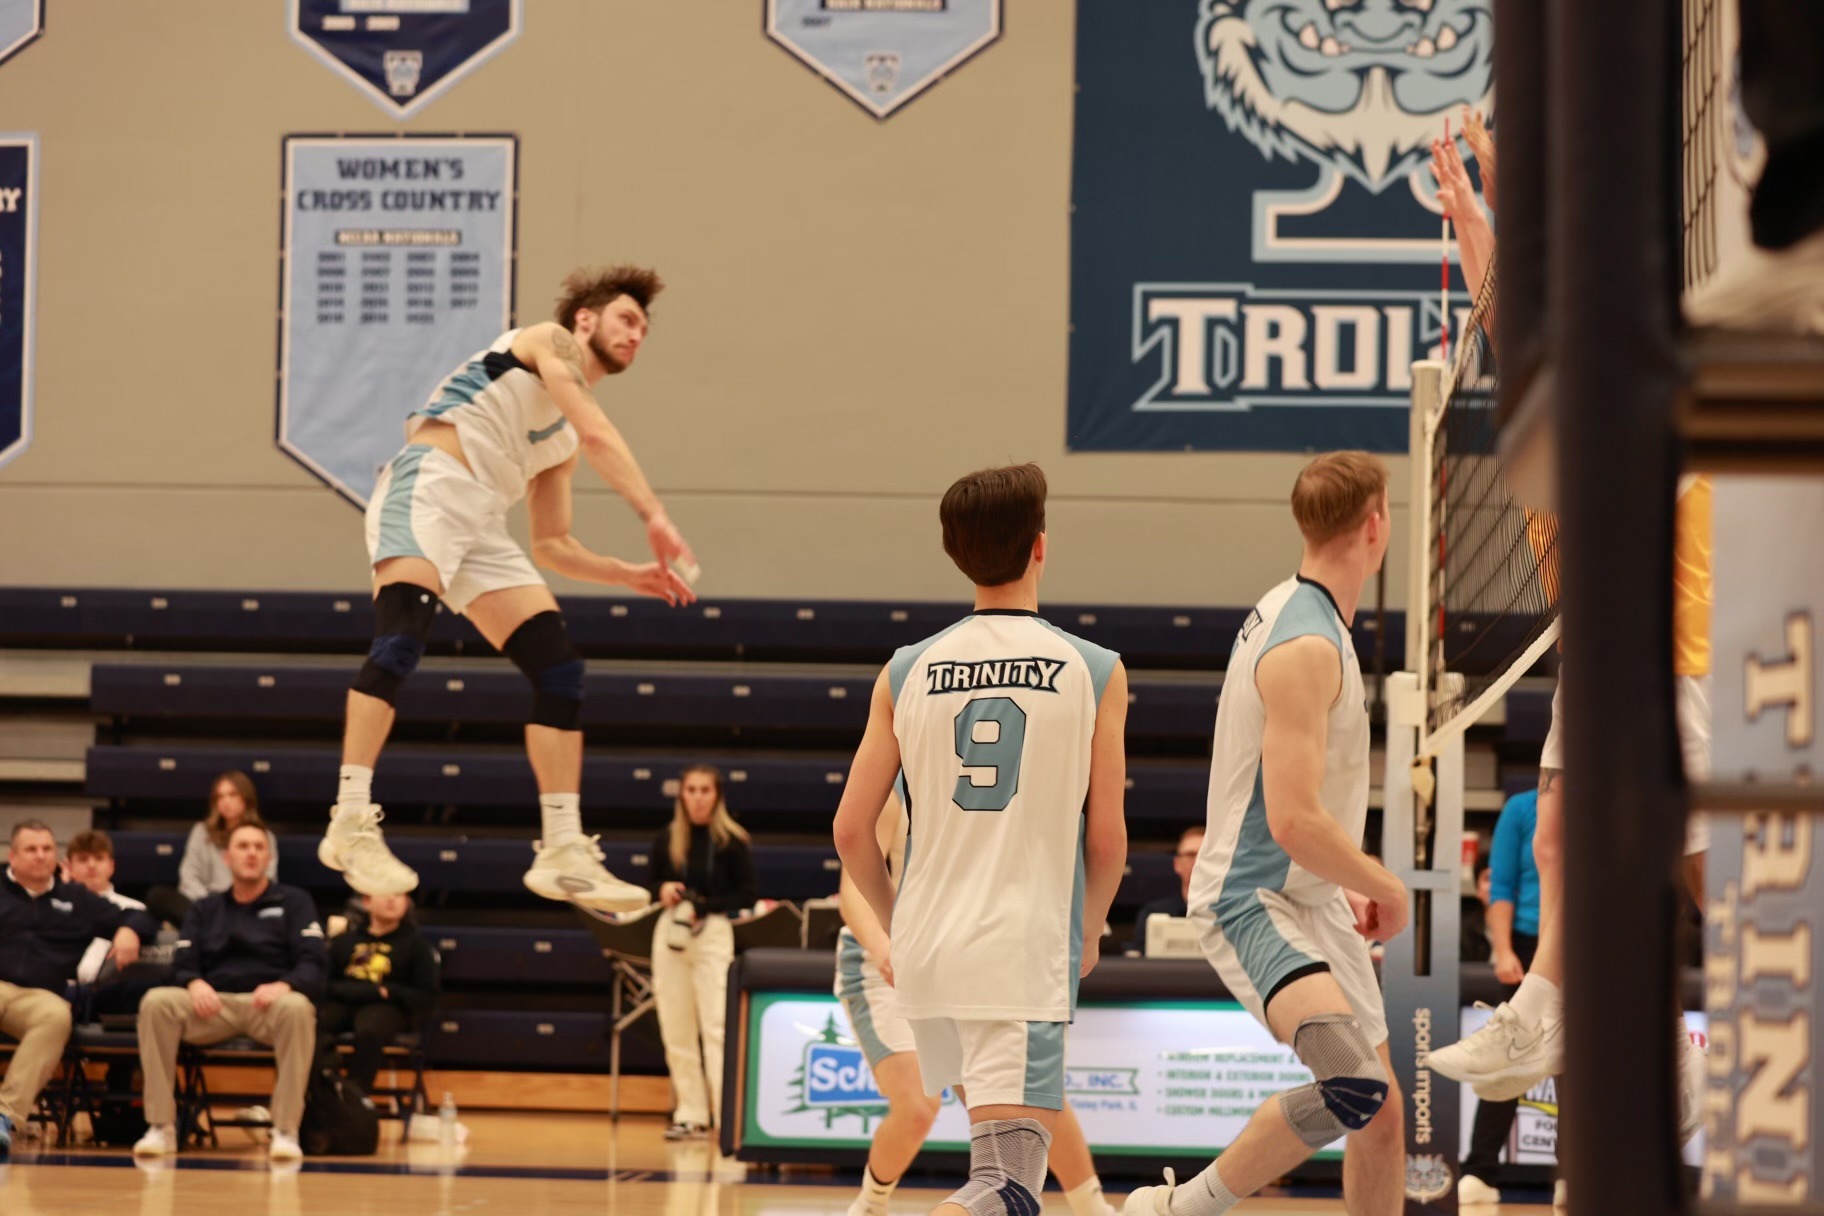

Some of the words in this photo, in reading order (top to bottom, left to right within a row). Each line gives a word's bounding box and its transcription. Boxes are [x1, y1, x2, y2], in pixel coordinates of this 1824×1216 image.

[337, 158, 464, 180] WOMEN'S
[297, 189, 373, 211] CROSS
[381, 189, 501, 212] COUNTRY
[927, 657, 1067, 695] TRINITY
[952, 697, 1026, 811] 9
[1411, 1008, 1432, 1068] sports
[810, 1056, 881, 1092] Sch
[1411, 1070, 1433, 1144] imports
